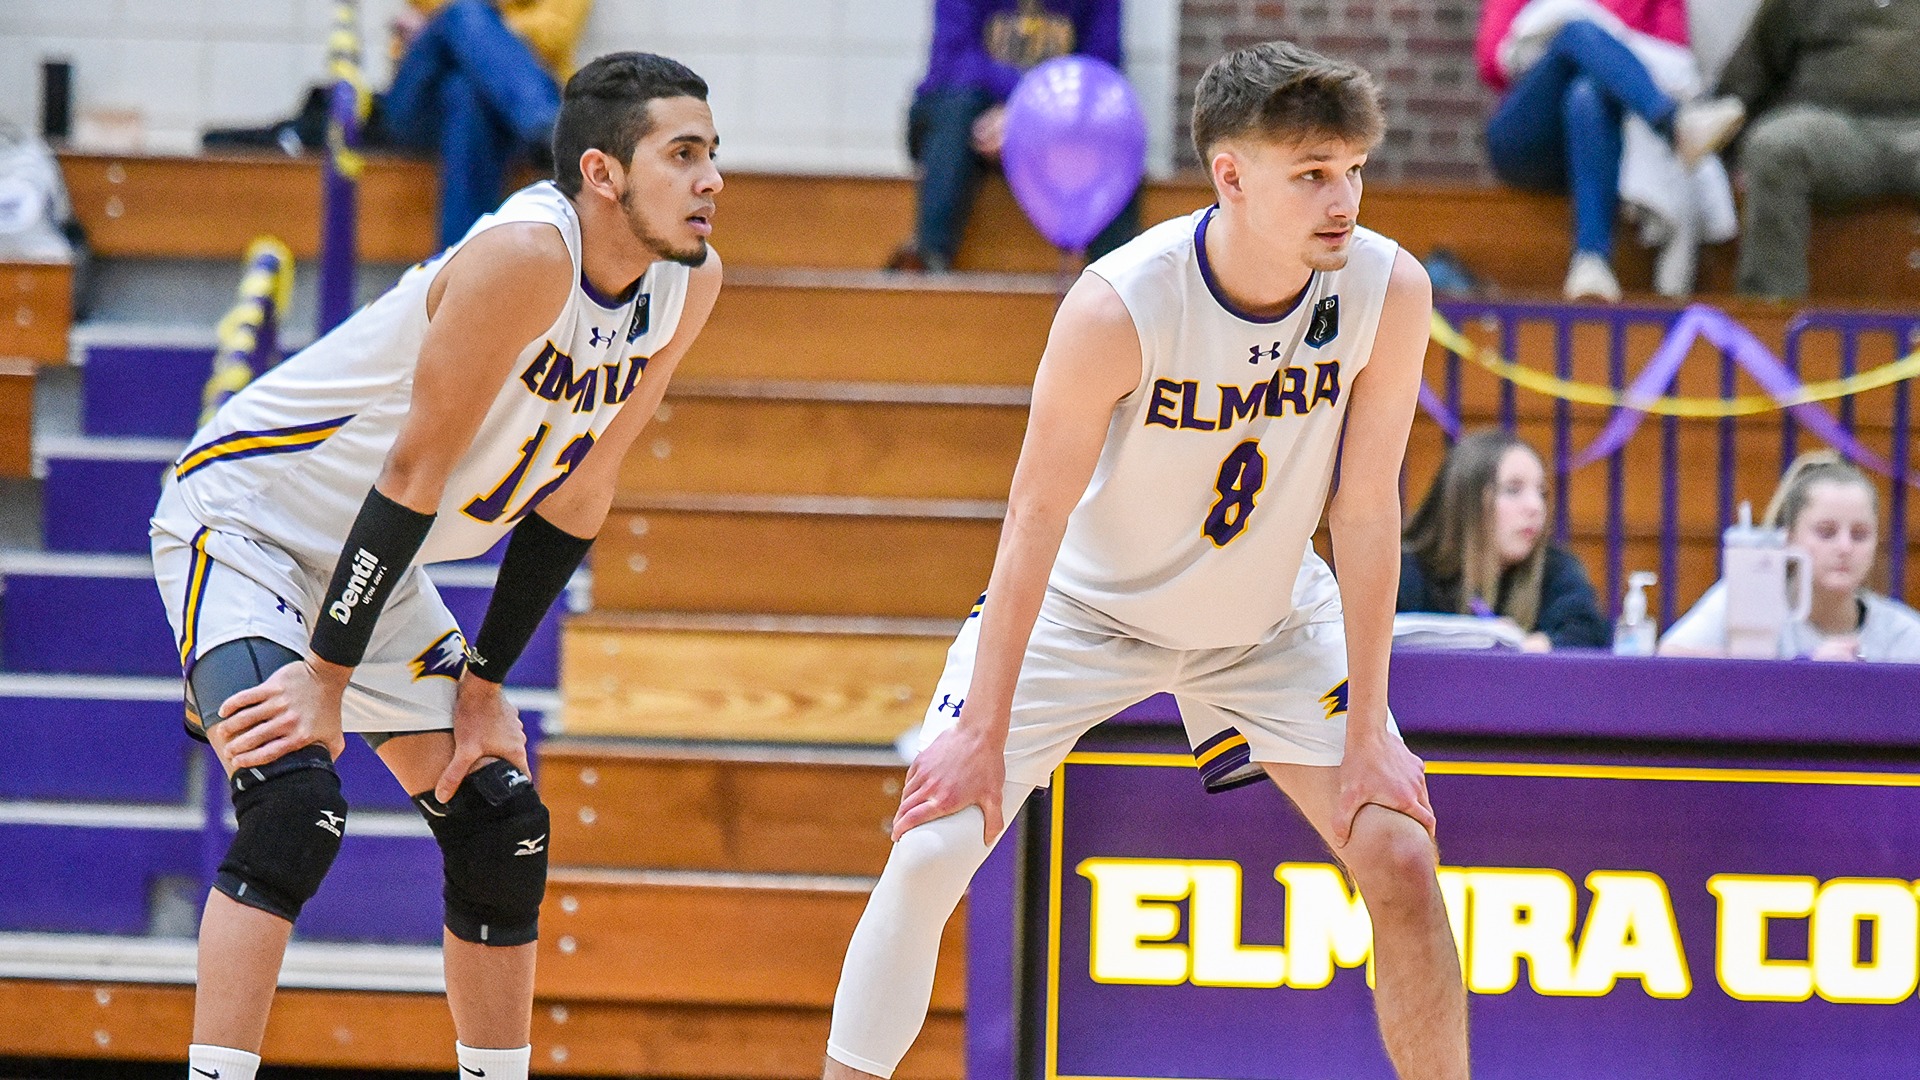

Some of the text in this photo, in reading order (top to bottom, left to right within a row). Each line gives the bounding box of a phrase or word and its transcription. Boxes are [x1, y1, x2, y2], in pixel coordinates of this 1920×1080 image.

[1144, 360, 1341, 432] ELMIRA
[458, 422, 597, 524] 12
[1200, 437, 1268, 549] 8
[329, 547, 379, 625] Dentil
[1706, 873, 1920, 1004] CO
